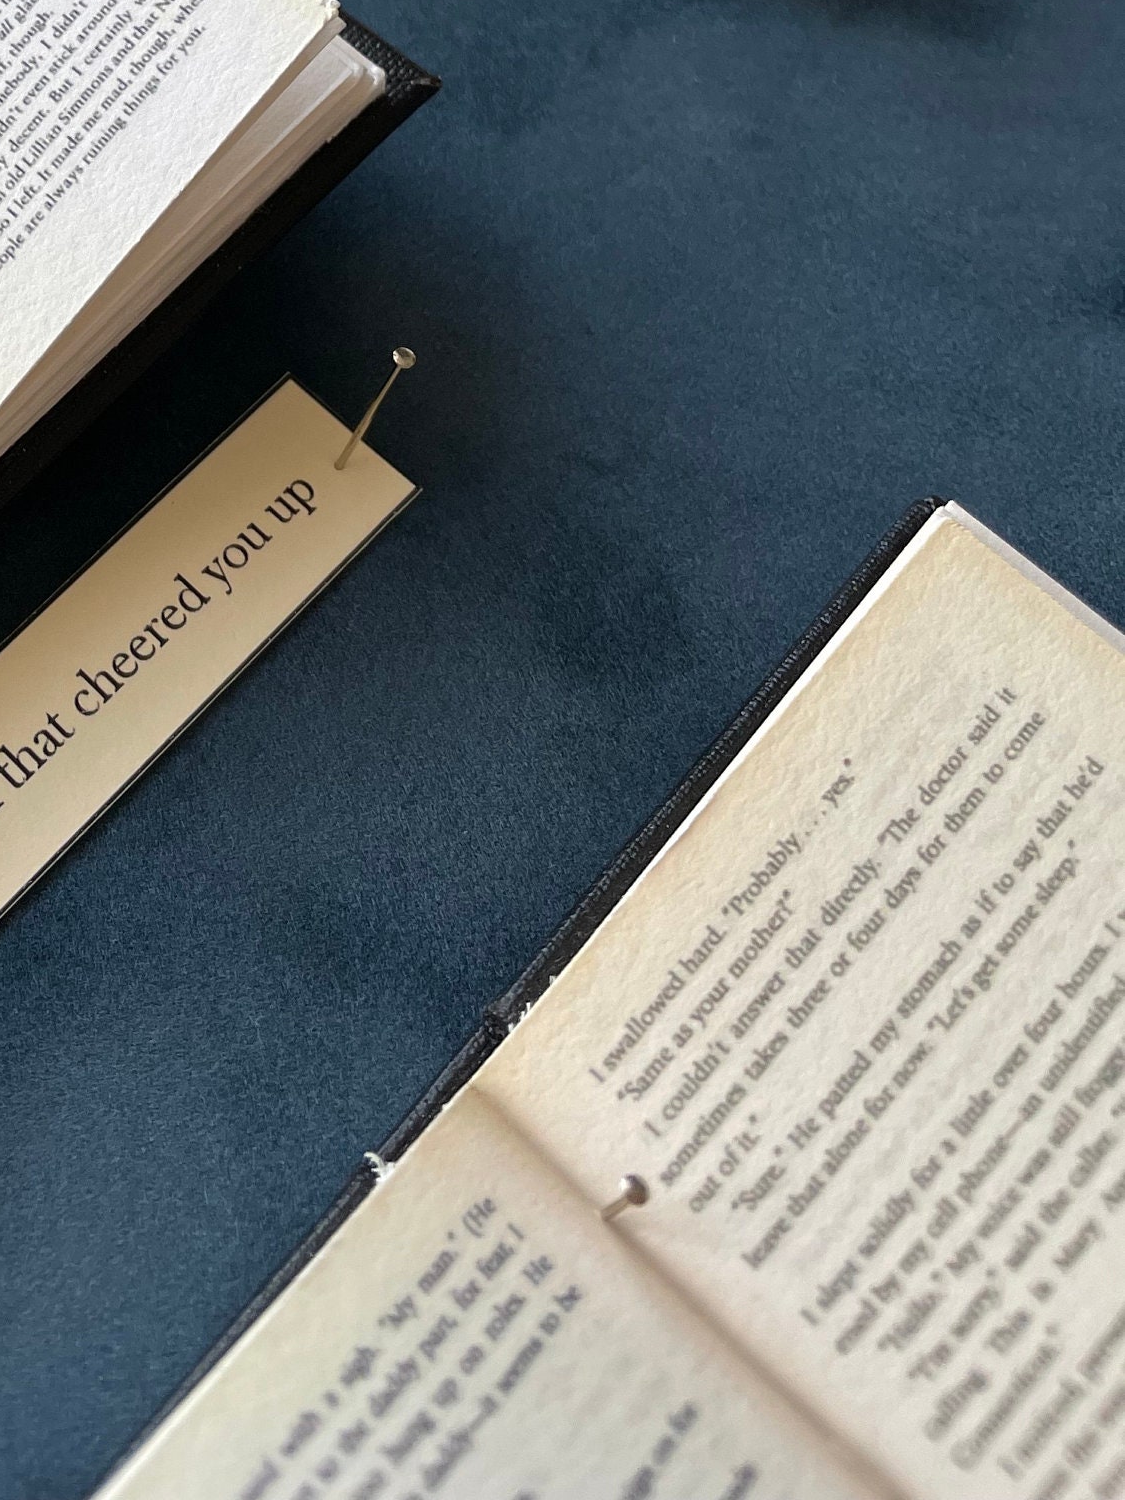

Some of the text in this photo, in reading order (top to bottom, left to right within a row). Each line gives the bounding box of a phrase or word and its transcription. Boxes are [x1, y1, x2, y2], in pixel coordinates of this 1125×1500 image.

[128, 27, 177, 77] though,
[3, 162, 26, 191] old
[20, 123, 63, 168] Lillian
[56, 64, 114, 126] Simmons
[110, 35, 136, 67] and
[131, 11, 160, 41] that
[23, 209, 45, 235] are
[43, 163, 84, 212] always
[80, 115, 128, 166] ruining
[121, 74, 161, 117] things
[154, 52, 179, 76] for
[175, 25, 206, 57] you.
[80, 109, 103, 133] me
[99, 76, 134, 111] mad,
[35, 167, 53, 183] It
[49, 130, 84, 170] made
[5, 205, 19, 219] I
[11, 184, 42, 210] left.
[73, 571, 211, 717] cheered
[200, 521, 273, 596] you
[263, 478, 317, 524] up
[642, 1119, 662, 1138] I
[728, 970, 787, 1040] answer
[783, 927, 823, 970] that
[819, 857, 882, 927] directly.
[916, 745, 969, 807] doctor
[966, 702, 1002, 746] said
[994, 686, 1018, 706] it
[658, 711, 1047, 1187] sometimes takes three or four days for them to come
[786, 1116, 822, 1151] He
[817, 1048, 873, 1121] patted
[868, 1016, 900, 1054] my
[895, 939, 964, 1020] stomach
[959, 914, 983, 940] as
[973, 887, 998, 916] if
[991, 871, 1016, 896] to
[1011, 837, 1042, 873] say
[1035, 799, 1074, 840] that
[587, 1067, 606, 1084] I
[602, 969, 687, 1072] swallowed
[676, 923, 728, 976] hard.
[670, 1022, 695, 1049] as
[688, 976, 732, 1029] your
[740, 1216, 793, 1270] leave
[785, 1172, 827, 1218] that
[820, 1117, 871, 1178] alone
[862, 1084, 896, 1121] for
[890, 1040, 934, 1090] now.
[969, 953, 1001, 993] get
[993, 903, 1041, 958] some
[687, 1174, 723, 1214] out
[717, 1143, 741, 1177] of
